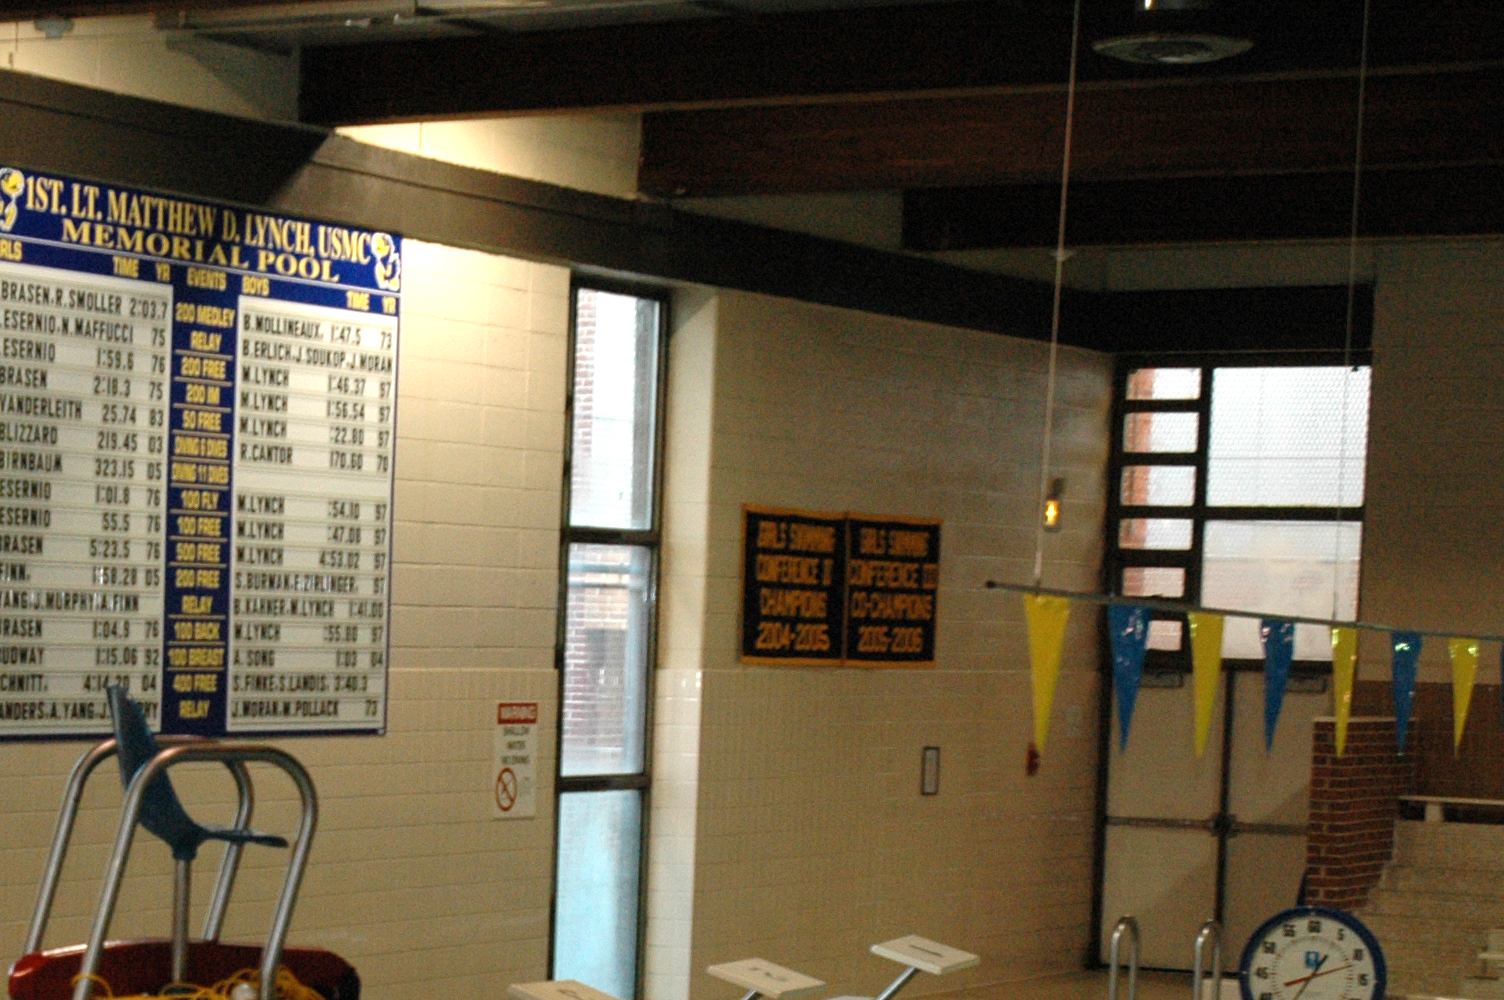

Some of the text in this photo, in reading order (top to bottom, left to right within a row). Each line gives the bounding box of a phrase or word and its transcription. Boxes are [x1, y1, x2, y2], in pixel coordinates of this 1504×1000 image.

[26, 176, 372, 265] 1ST. LT. MATTHEW D. LYNCH, USMC
[62, 218, 340, 283] MEMORIAL POOL
[112, 256, 139, 278] TIME
[187, 267, 226, 292] EVENTS
[242, 276, 270, 296] BOYS
[346, 291, 370, 311] TIME
[176, 302, 235, 328] 200 MEDLEY
[151, 328, 166, 347] 75
[191, 330, 222, 352] RELAY
[381, 331, 393, 350] 73
[151, 354, 166, 374] 76
[181, 356, 226, 380] 200 FREE
[149, 381, 163, 400] 75
[186, 383, 206, 404] 200
[380, 382, 391, 399] 97
[102, 404, 137, 424] 25.74
[182, 410, 222, 432] 50 FREE
[379, 406, 390, 423] 97
[378, 430, 390, 448] 97
[146, 488, 160, 506] 76
[181, 490, 219, 510] 100 FLY
[375, 503, 386, 520] 97
[146, 514, 160, 532] 76
[178, 516, 222, 537] 100 FREE
[374, 528, 386, 546] 97
[146, 540, 160, 560] 76
[197, 543, 221, 563] FREE
[374, 552, 386, 570] 97
[756, 554, 820, 584] CONFERENCE
[196, 569, 220, 589] FREE
[848, 560, 920, 588] CONFERENCE
[182, 595, 213, 614] RELAY
[760, 588, 828, 618] CHAMPIONS
[852, 592, 933, 620] CO-CHAMPIONS
[144, 620, 159, 638] 76
[174, 621, 220, 640] 100 BACK
[144, 648, 159, 666] 92
[168, 648, 224, 666] 100 BREAST
[142, 674, 156, 692] 04
[173, 674, 218, 692] 400 FREE
[180, 700, 210, 718] RELAY
